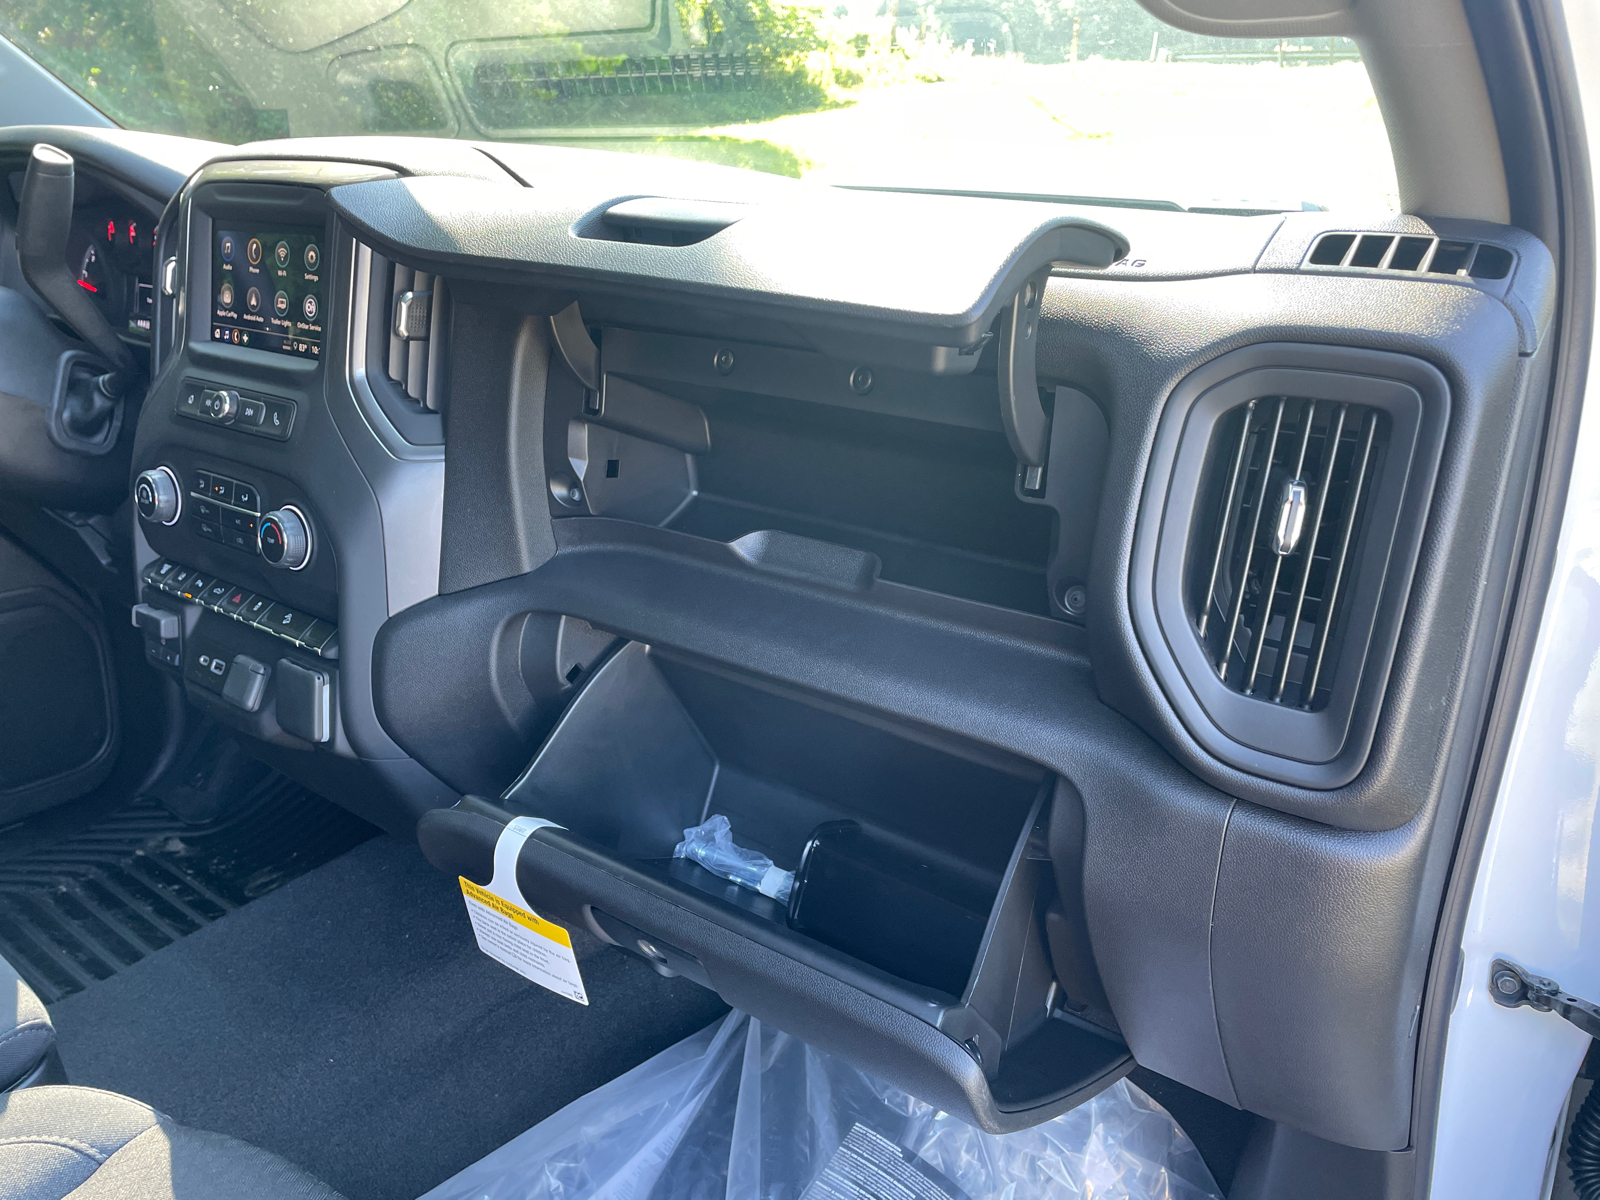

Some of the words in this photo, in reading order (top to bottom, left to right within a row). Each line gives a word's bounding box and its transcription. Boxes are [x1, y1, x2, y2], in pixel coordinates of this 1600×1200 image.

[304, 273, 319, 282] Settings
[226, 310, 238, 319] CarPlay
[243, 314, 256, 322] Android
[281, 320, 292, 328] Lights
[296, 322, 309, 330] OnStar
